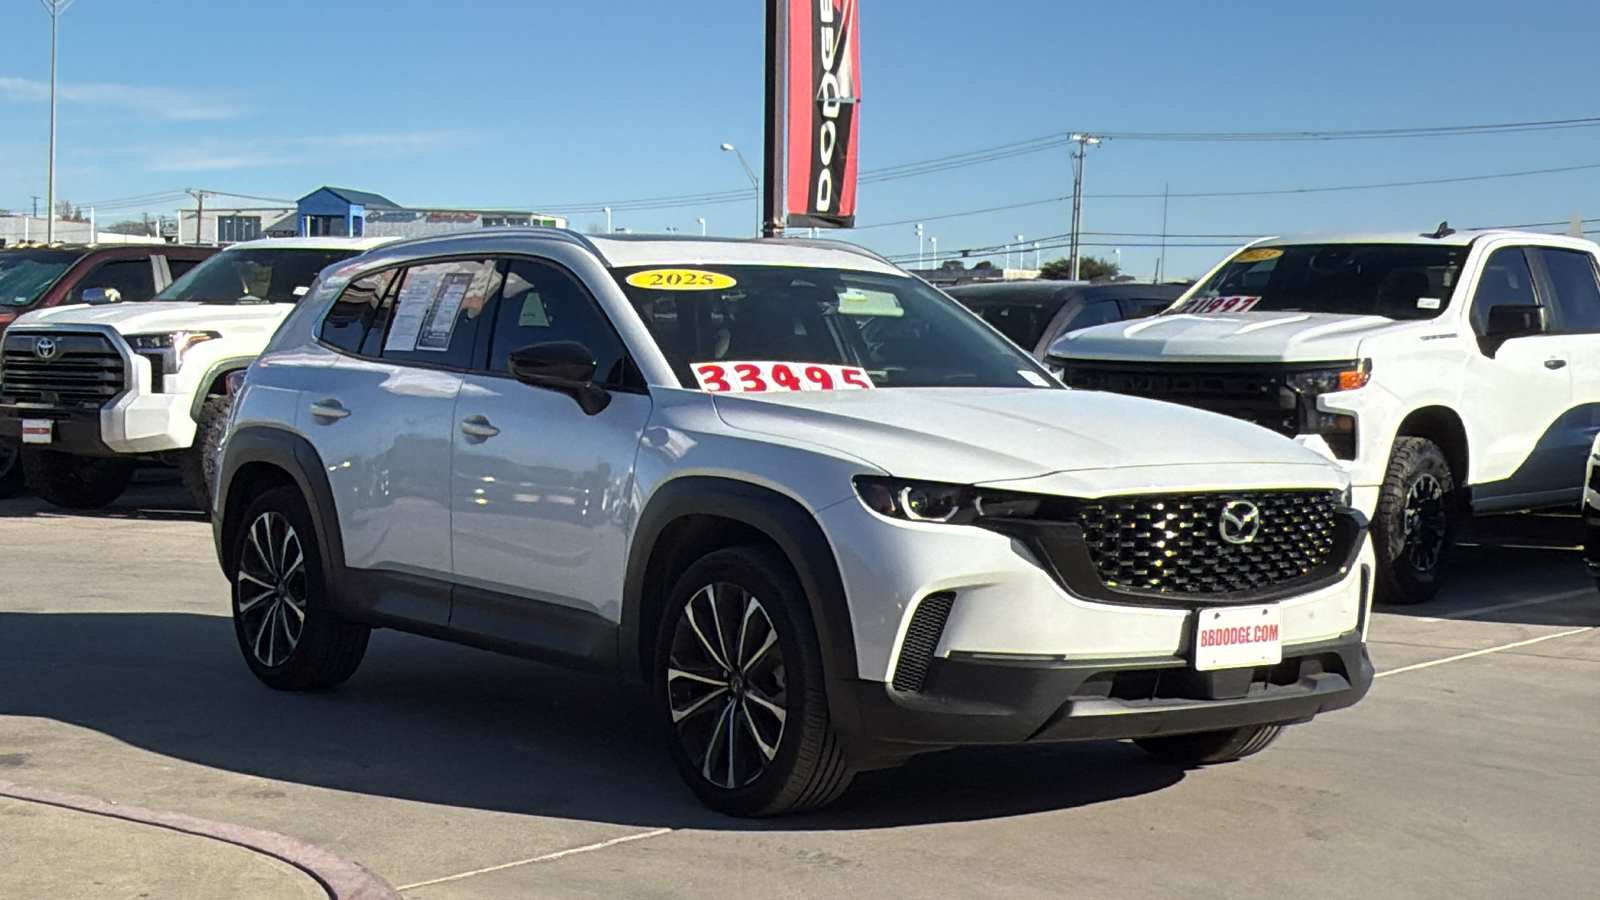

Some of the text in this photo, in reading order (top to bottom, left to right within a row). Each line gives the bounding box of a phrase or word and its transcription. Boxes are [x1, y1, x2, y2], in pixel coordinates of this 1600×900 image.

[816, 0, 840, 212] DODGE
[649, 273, 714, 286] 2025
[697, 364, 870, 392] 33495
[1200, 624, 1279, 647] BBDODGE.COM
